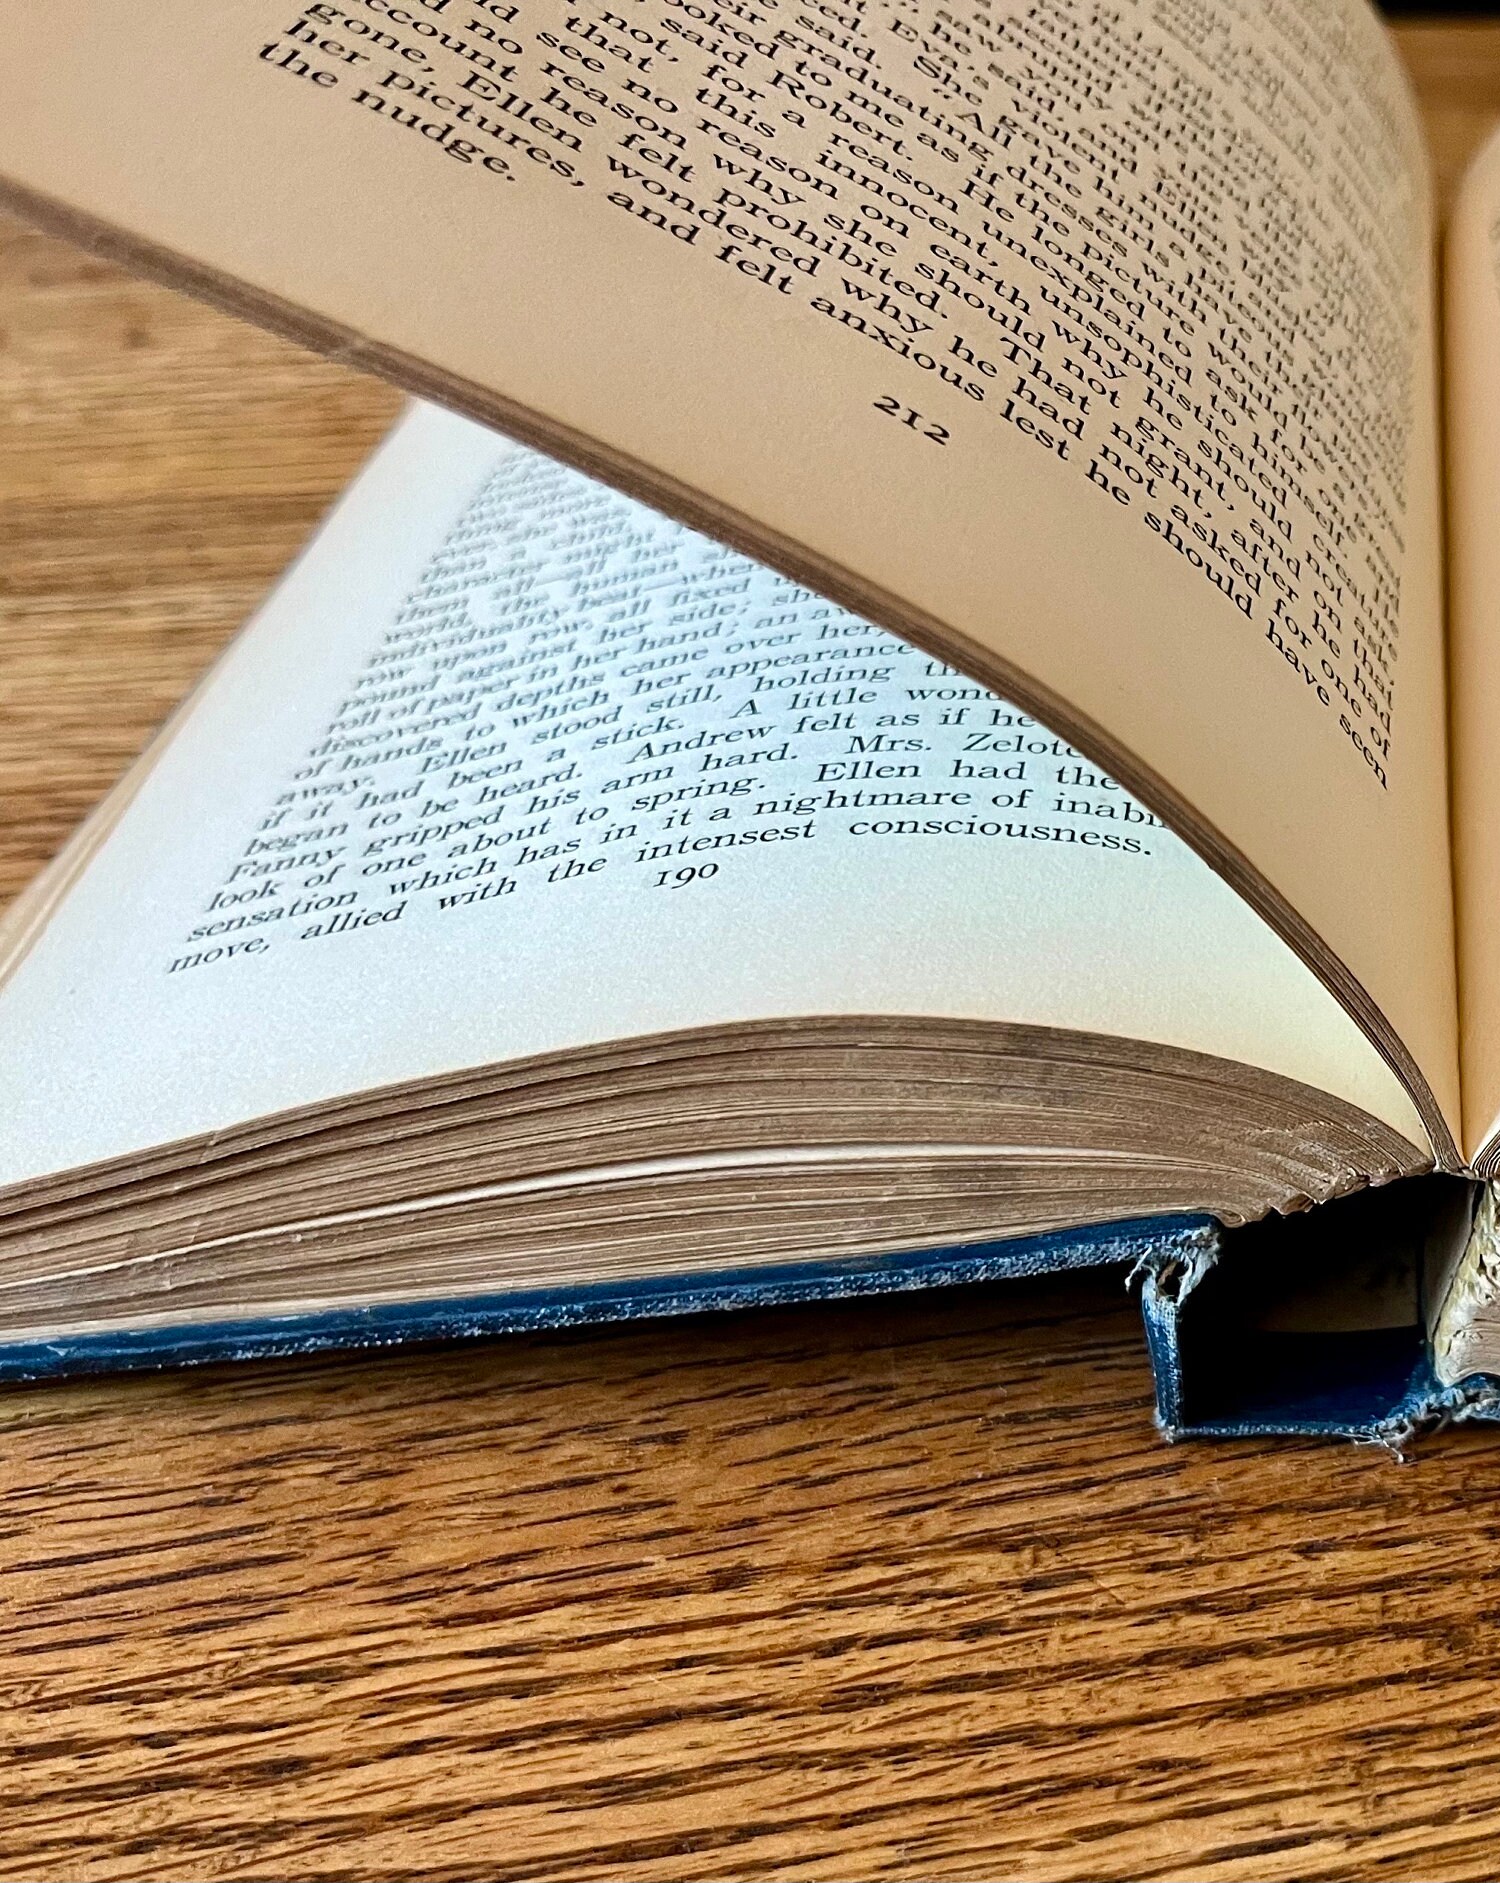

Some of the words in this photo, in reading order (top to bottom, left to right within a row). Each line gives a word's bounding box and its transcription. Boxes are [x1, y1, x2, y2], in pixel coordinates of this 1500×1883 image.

[258, 42, 339, 88] the
[351, 89, 516, 182] nudge.
[284, 20, 369, 65] her
[378, 71, 585, 187] pictures,
[607, 192, 701, 245] and
[714, 245, 795, 295] felt
[810, 298, 985, 401] anxious
[1000, 400, 1070, 461] lest
[1085, 460, 1132, 506] he
[1144, 512, 1253, 619] should
[1265, 619, 1331, 706] have
[1339, 714, 1388, 790] seen
[304, 3, 435, 72] gone,
[455, 71, 583, 153] Ellen
[605, 156, 820, 277] wondered
[841, 279, 934, 334] why
[948, 337, 998, 377] he
[1012, 377, 1085, 439] had
[1100, 443, 1159, 498] not
[1171, 505, 1262, 596] asked
[1274, 598, 1312, 649] for
[1322, 660, 1362, 717] one
[1371, 727, 1391, 760] of
[539, 88, 597, 128] he
[618, 134, 698, 183] felt
[713, 188, 949, 319] prohibited.
[1001, 337, 1091, 414] That
[1111, 422, 1212, 518] night,
[1231, 530, 1299, 601] after
[1311, 612, 1341, 657] he
[1353, 665, 1391, 734] had
[873, 395, 950, 446] 212
[187, 890, 359, 943] sensation
[388, 858, 498, 897] which
[513, 837, 582, 866] has
[600, 824, 638, 845] in
[662, 809, 692, 830] it
[708, 804, 732, 820] a
[752, 789, 972, 816] nightmare
[992, 790, 1032, 809] of
[206, 880, 281, 913] look
[304, 866, 341, 890] of
[361, 854, 427, 876] one
[447, 817, 553, 858] about
[575, 805, 610, 825] to
[632, 773, 767, 813] spring.
[813, 761, 922, 784] Ellen
[949, 759, 1027, 780] had
[228, 845, 348, 885] Fanny
[361, 808, 504, 858] gripped
[525, 787, 581, 815] his
[600, 763, 674, 795] arm
[698, 743, 798, 772] hard.
[845, 734, 932, 756] Mrs.
[652, 863, 719, 889] 190
[167, 936, 270, 974] move,
[300, 901, 408, 941] allied
[438, 876, 517, 912] with
[546, 854, 608, 884] the
[633, 819, 817, 864] intensest
[849, 816, 1153, 857] consciousness.
